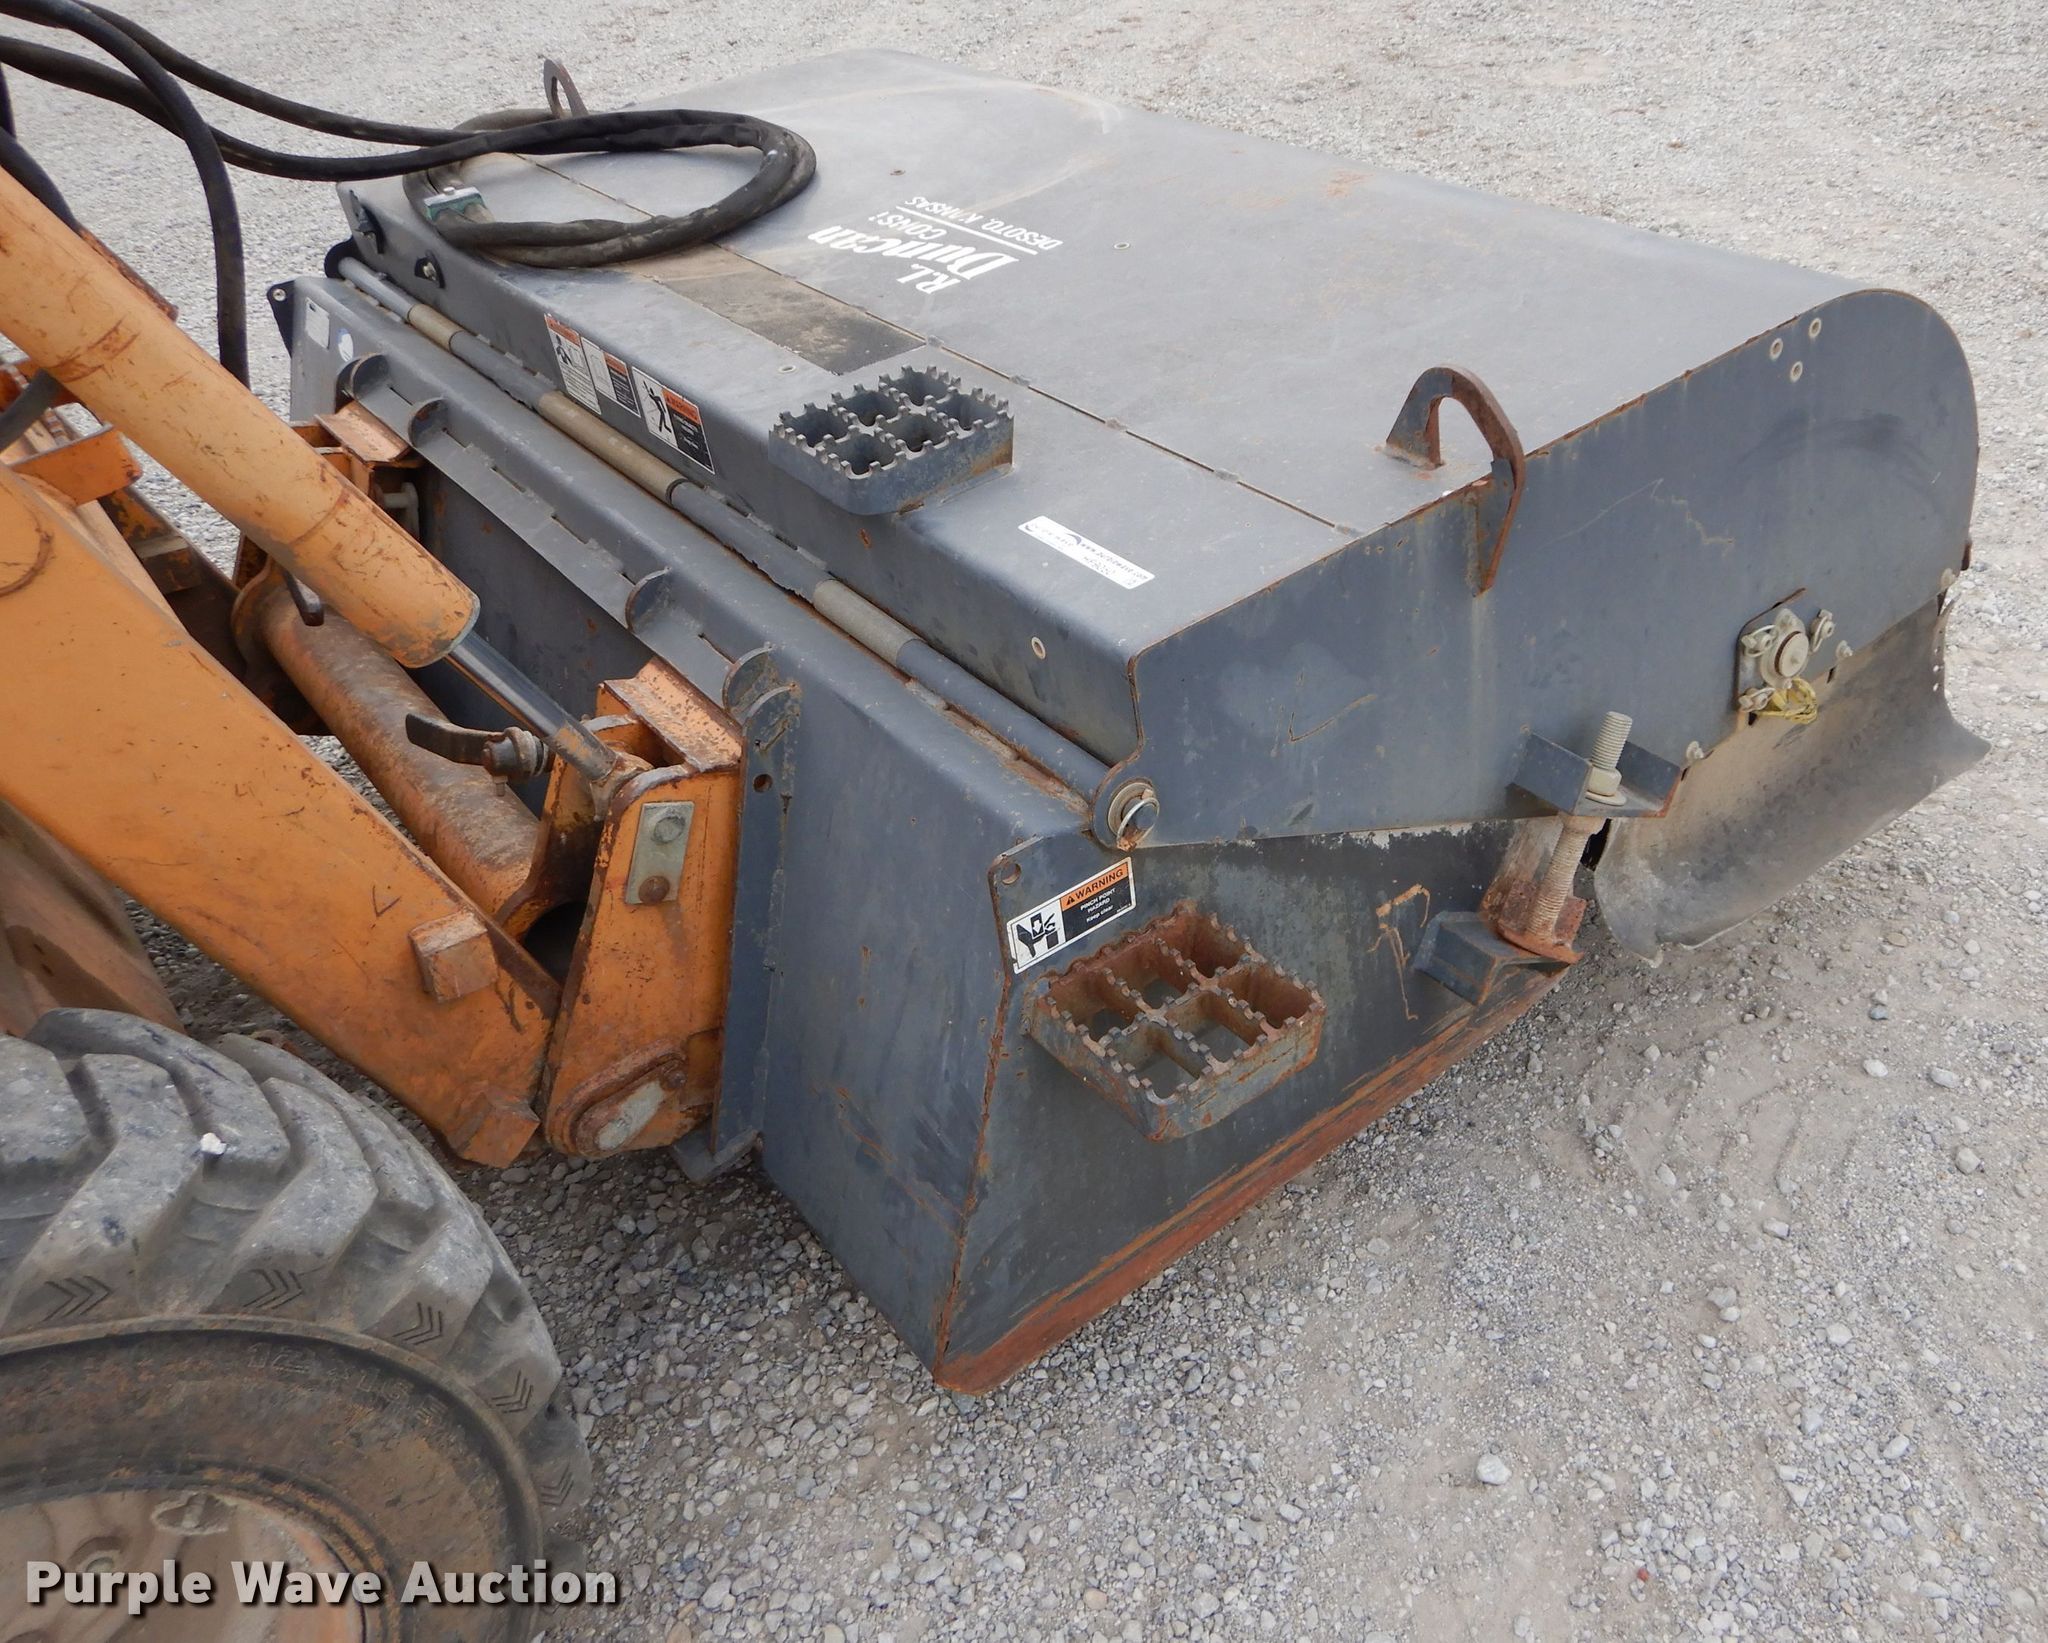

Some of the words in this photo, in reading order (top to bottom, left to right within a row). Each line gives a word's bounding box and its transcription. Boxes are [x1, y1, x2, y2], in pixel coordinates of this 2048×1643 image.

[807, 225, 1020, 280] Duncan
[1075, 868, 1124, 900] WARNING
[1080, 896, 1099, 911] PINCH
[1098, 887, 1116, 901] POINT
[1087, 897, 1111, 913] HAZARD
